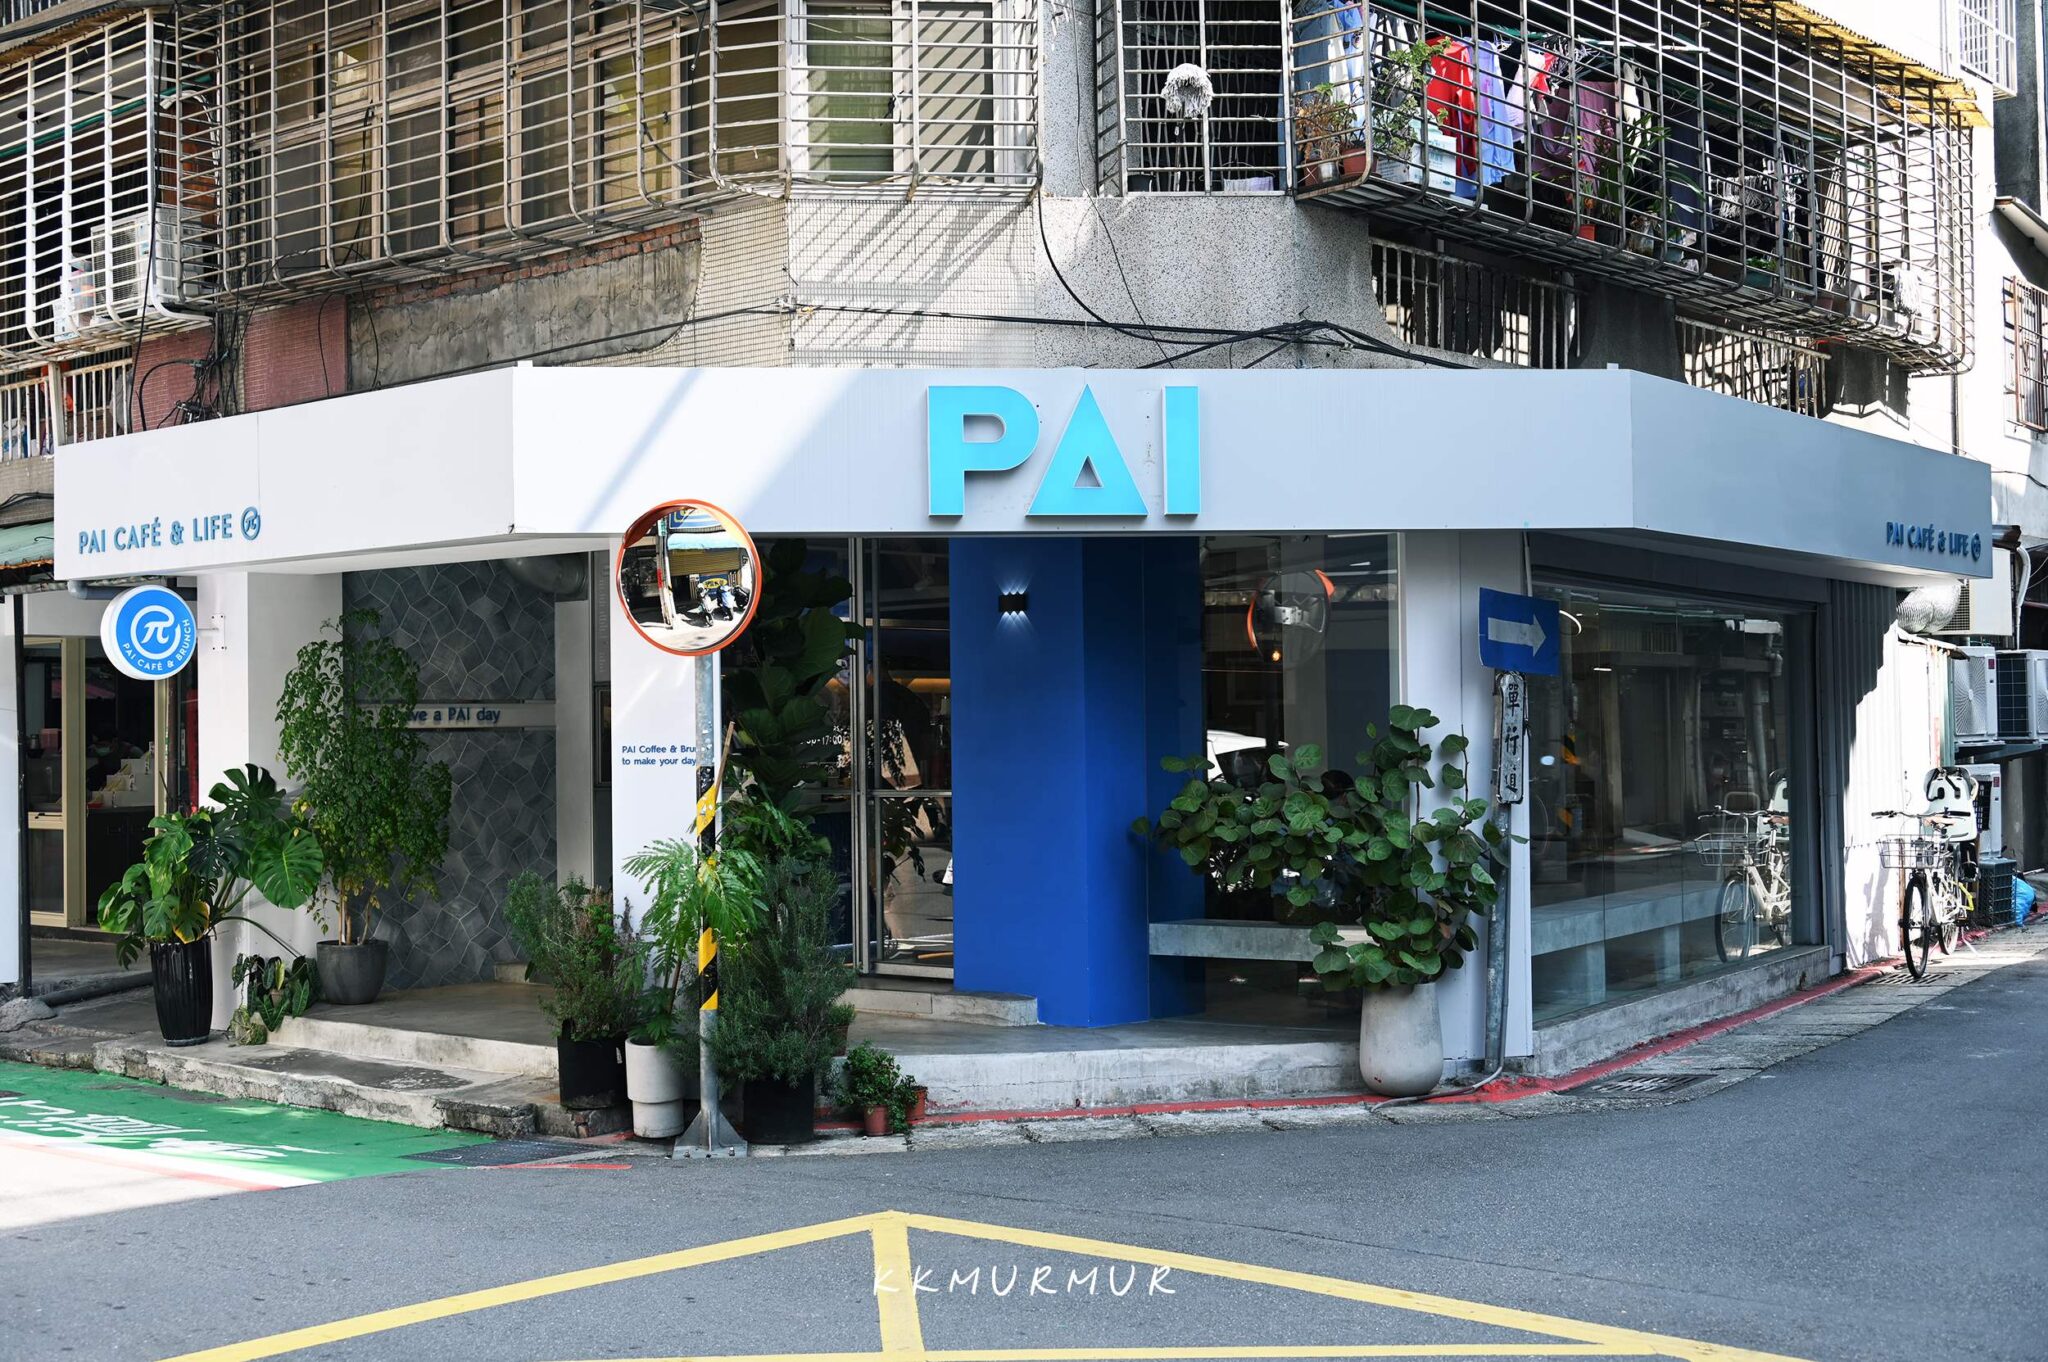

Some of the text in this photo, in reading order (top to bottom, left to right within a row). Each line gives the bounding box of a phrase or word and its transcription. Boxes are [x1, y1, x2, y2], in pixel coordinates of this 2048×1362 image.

[927, 383, 1201, 517] PAI
[78, 529, 106, 554] PAI
[113, 516, 162, 551] CAFÉ
[170, 520, 184, 546] &
[193, 513, 233, 542] LIFE
[1886, 521, 1904, 546] PAI
[1907, 523, 1935, 552] CAFÉ
[1948, 532, 1970, 557] LIFE
[123, 619, 191, 671] PAI CAFÉ & BRUNCH
[433, 710, 442, 722] a
[448, 707, 470, 722] PAI
[476, 707, 501, 724] day
[622, 757, 696, 767] to make your day
[639, 745, 666, 753] Coffee
[670, 745, 677, 753] &
[681, 745, 696, 753] Bru
